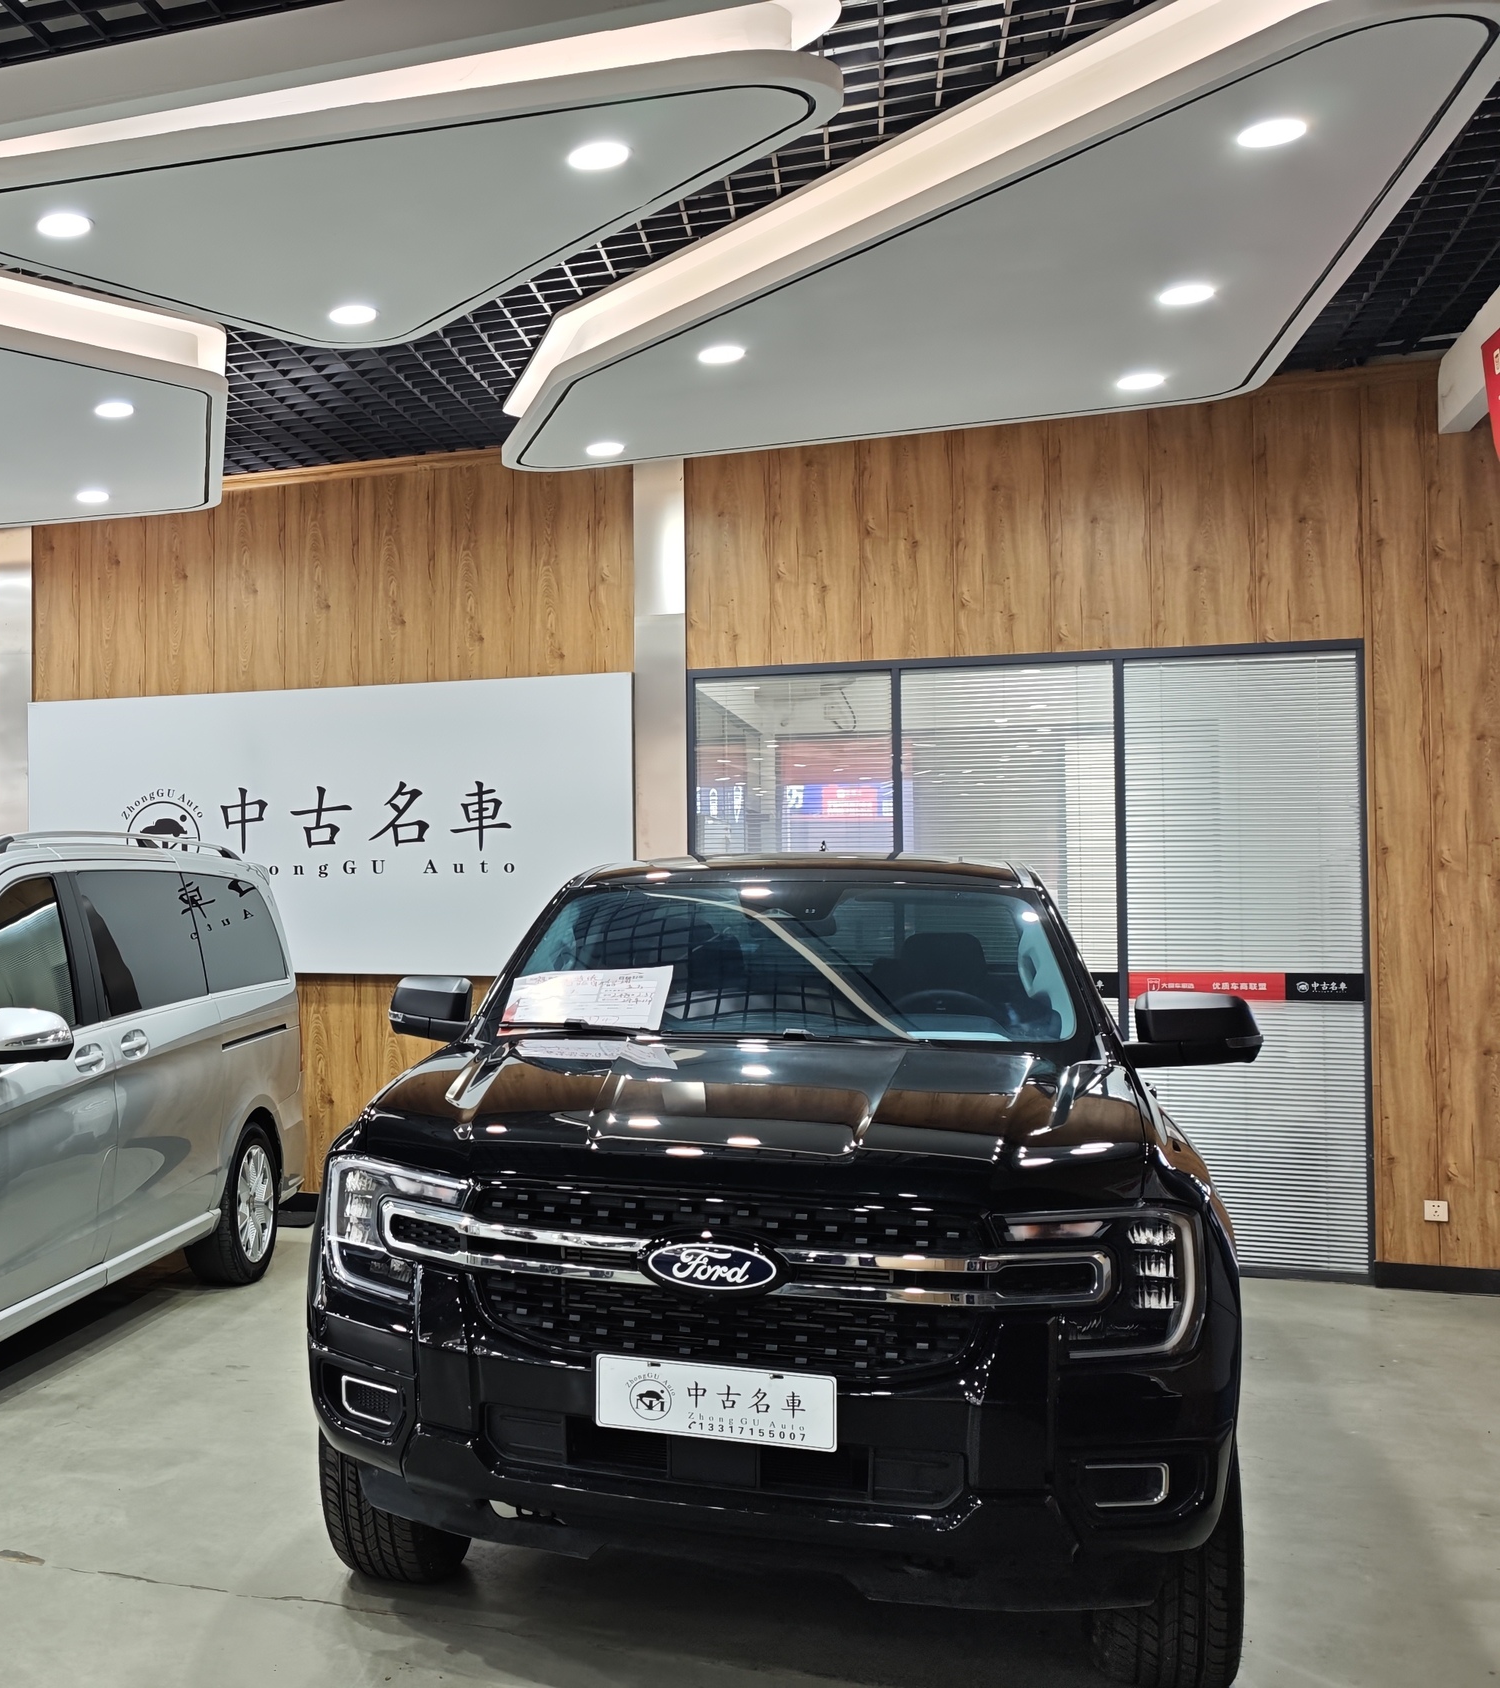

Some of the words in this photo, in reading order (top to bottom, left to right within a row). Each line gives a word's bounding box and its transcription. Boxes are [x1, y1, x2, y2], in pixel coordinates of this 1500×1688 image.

[121, 788, 176, 820] ZhongGU
[178, 793, 204, 819] Auto
[220, 780, 512, 854] 中古名車
[268, 859, 385, 878] ongGU
[423, 859, 516, 875] Auto
[1212, 982, 1267, 991] 优质车商联盟
[672, 1250, 752, 1283] Ford
[625, 1372, 660, 1389] ZhongGU
[687, 1381, 806, 1419] 中古名車
[688, 1411, 760, 1427] ZhongGU
[769, 1421, 805, 1431] Auto
[699, 1422, 806, 1442] 13317155007
